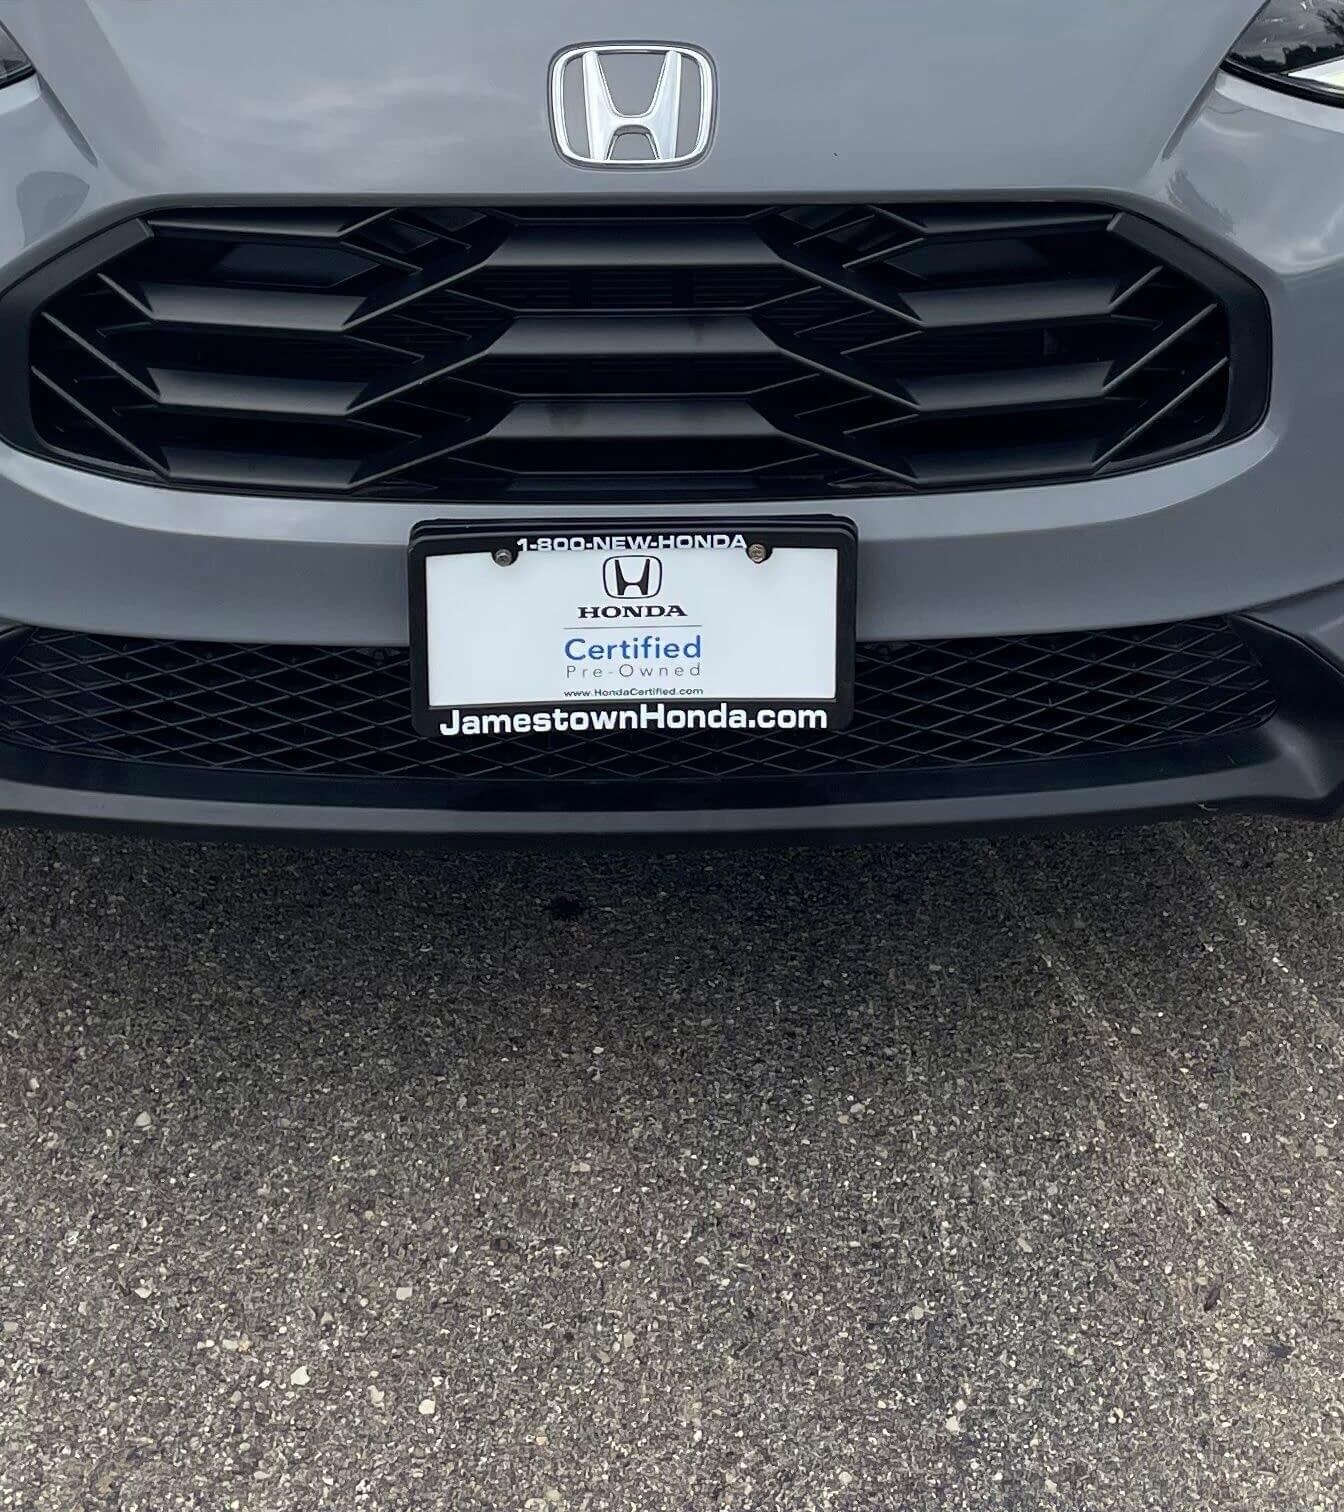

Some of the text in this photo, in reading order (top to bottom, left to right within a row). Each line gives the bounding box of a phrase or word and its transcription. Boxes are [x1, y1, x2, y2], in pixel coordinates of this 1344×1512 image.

[516, 534, 748, 552] 1-800-NEW-HONDA
[577, 605, 688, 619] HONDA
[564, 635, 702, 661] Certified
[566, 662, 701, 679] Pre-Owned
[563, 687, 704, 698] www.HondaCertified.com
[439, 702, 828, 736] JamestownHonda.com
